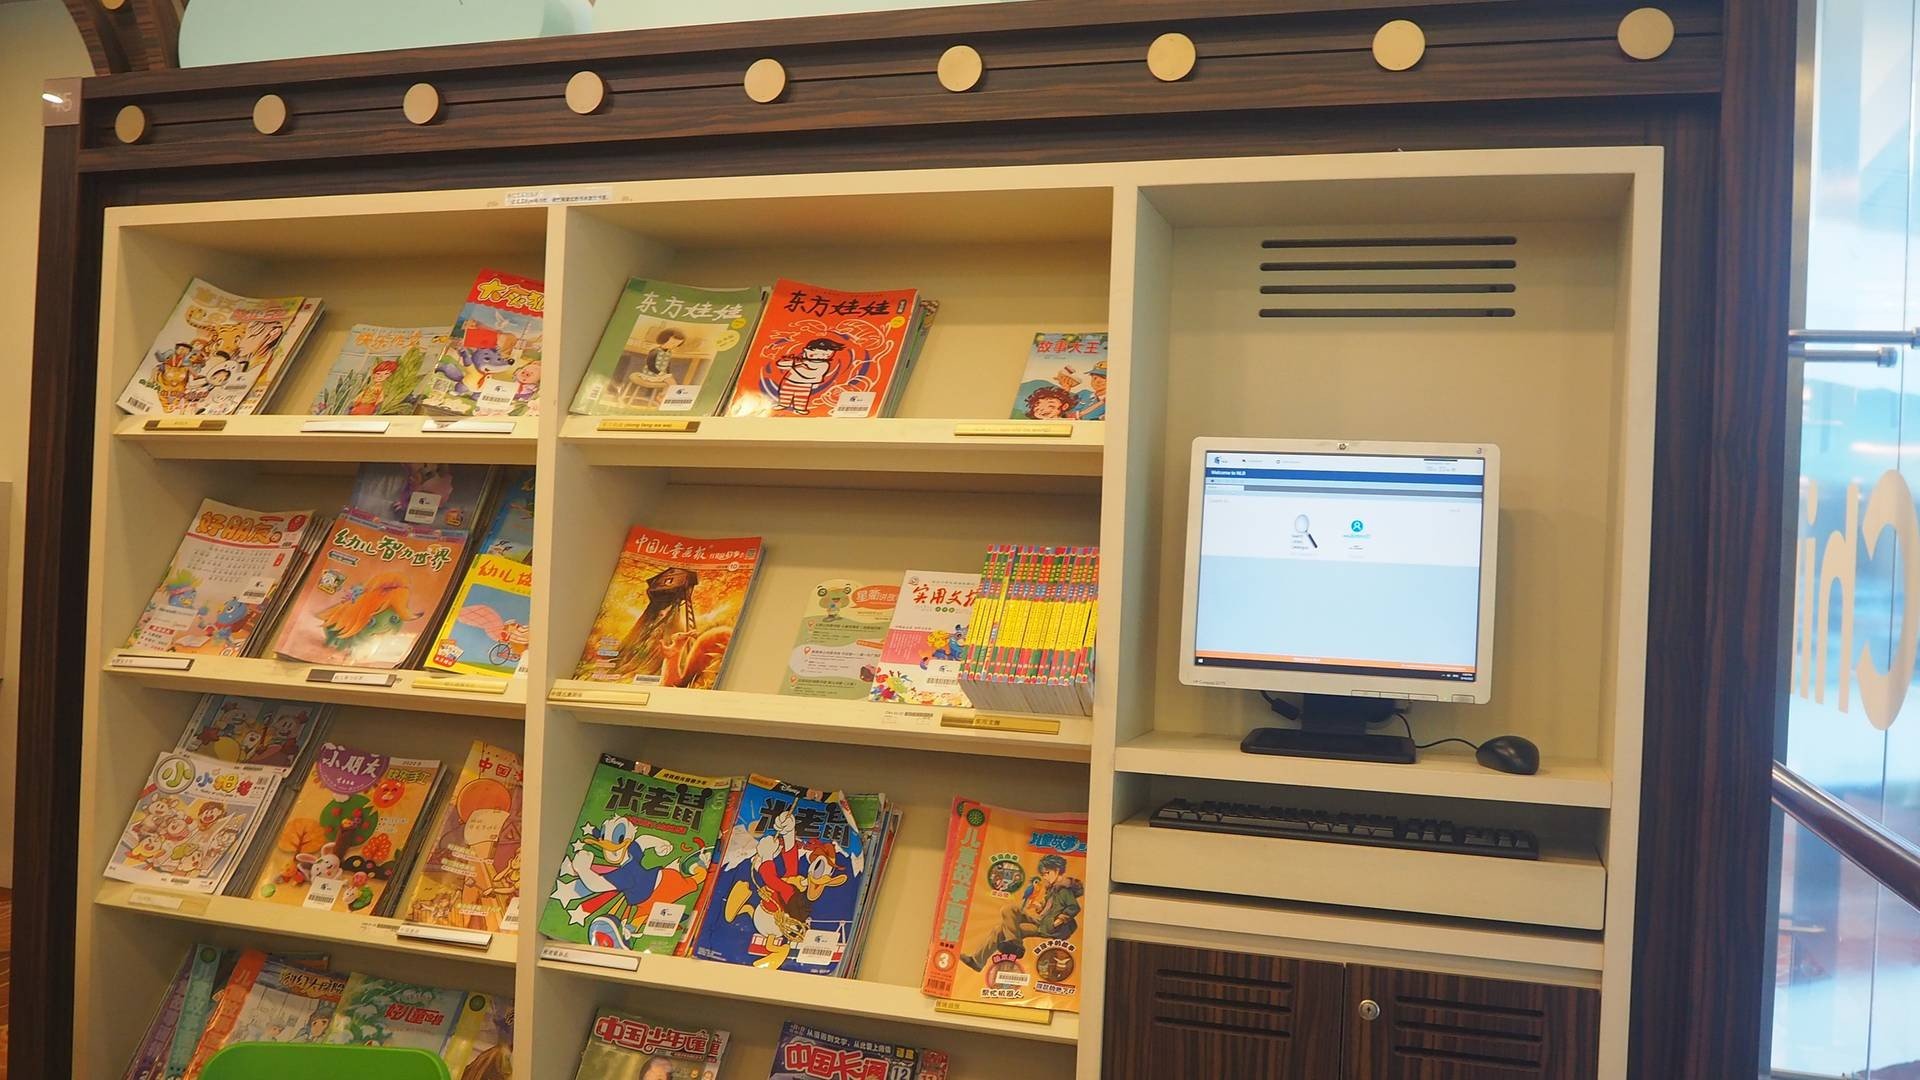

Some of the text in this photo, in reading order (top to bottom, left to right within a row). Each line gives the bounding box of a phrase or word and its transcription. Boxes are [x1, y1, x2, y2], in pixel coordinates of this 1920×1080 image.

[636, 290, 742, 320] 东方娃娃
[784, 290, 890, 317] 东方娃娃
[1037, 340, 1100, 354] 故事大王
[333, 528, 452, 573] 幼儿智力世界
[635, 534, 706, 560] 中国儿童画报
[322, 748, 382, 779] 小朋友
[602, 755, 625, 769] Disney
[779, 782, 801, 796] Disney
[605, 777, 713, 832] 米老鼠
[755, 798, 857, 848] 米老鼠
[938, 952, 950, 968] 3
[595, 1015, 709, 1054] 中国少年儿童
[784, 1042, 890, 1080] 中国卡通
